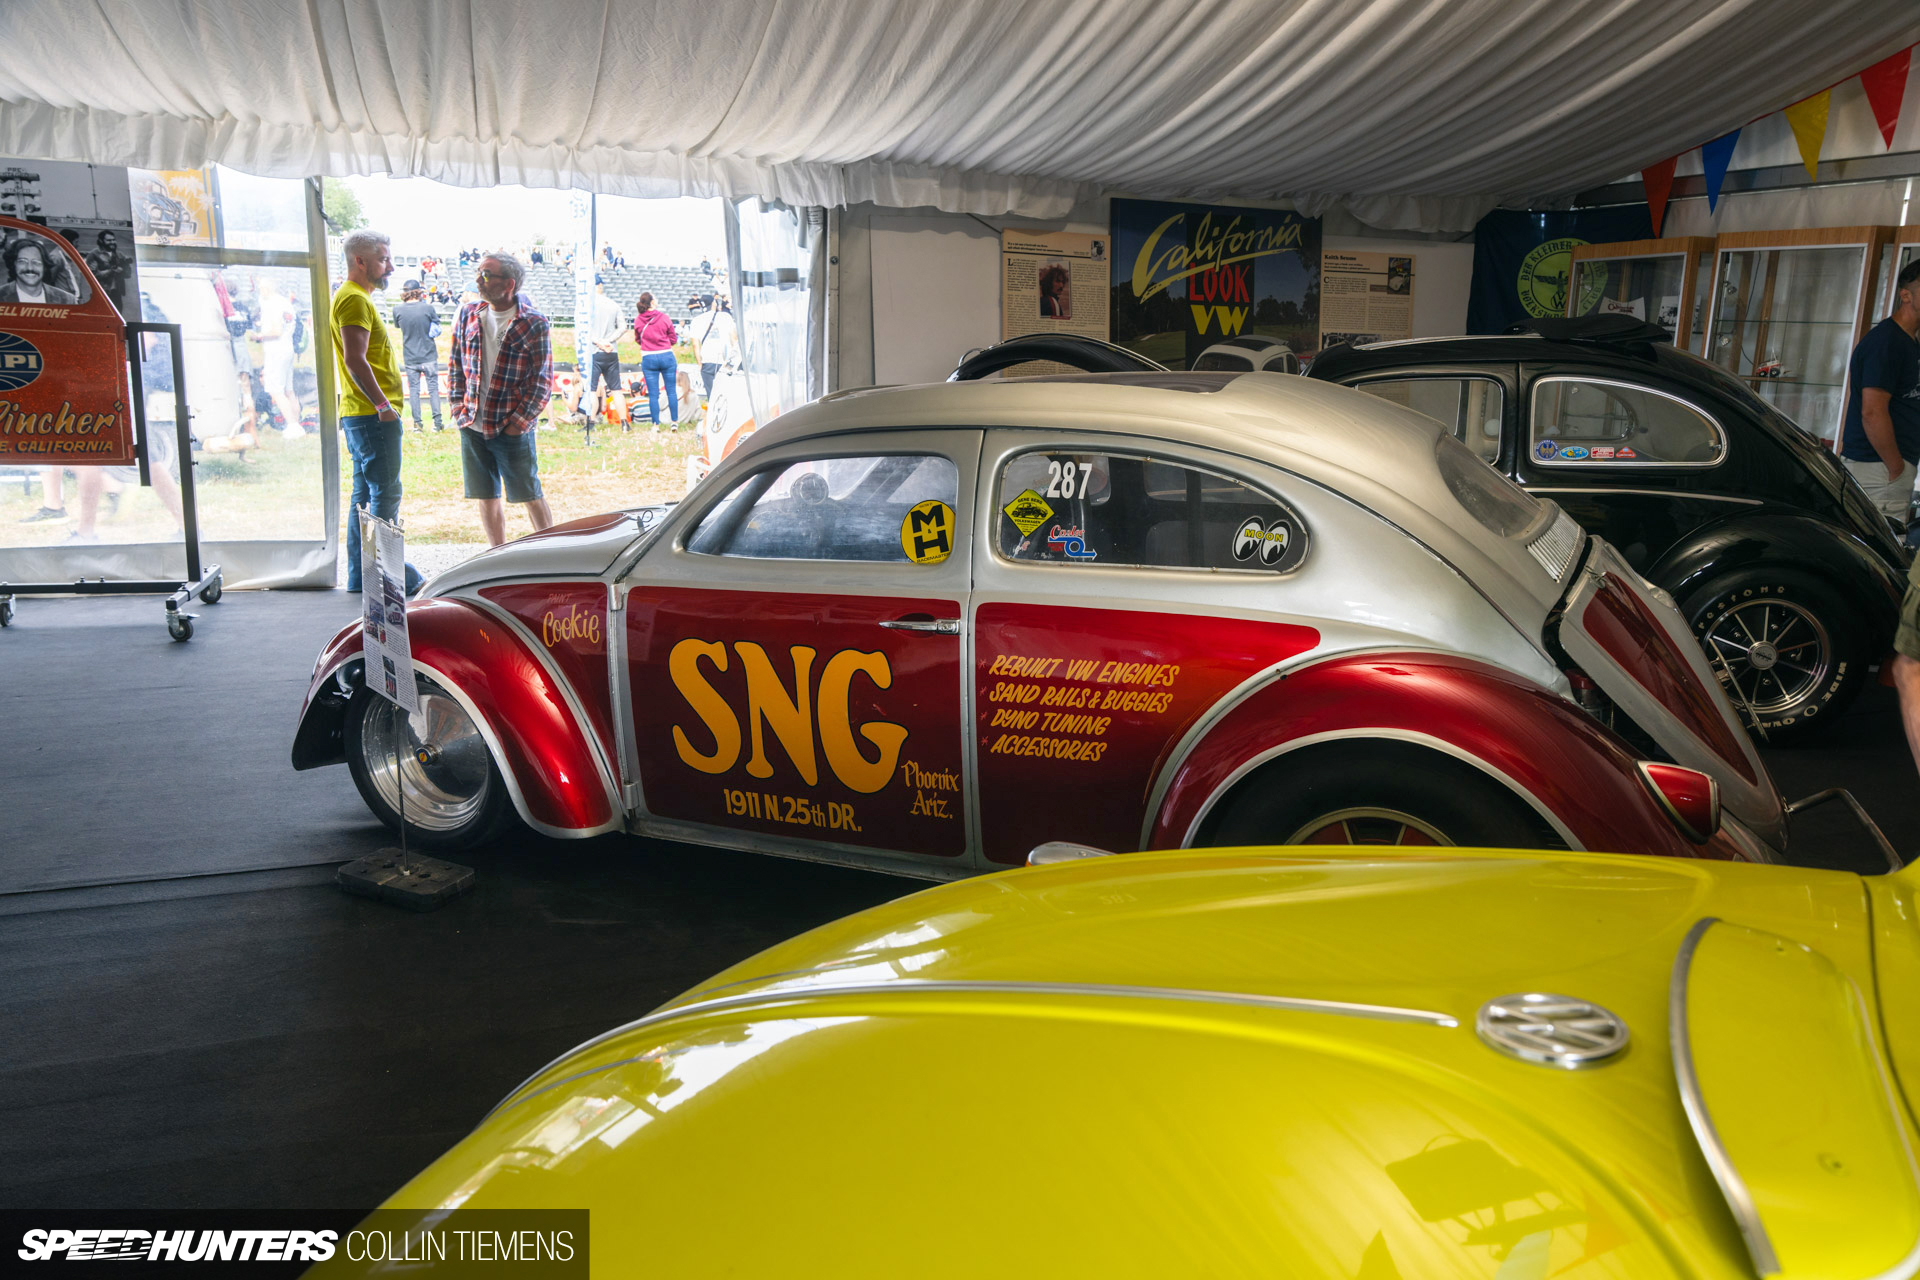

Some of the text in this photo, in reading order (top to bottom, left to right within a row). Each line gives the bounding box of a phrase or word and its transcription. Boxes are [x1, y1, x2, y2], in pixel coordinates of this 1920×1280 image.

[1132, 210, 1302, 298] California
[1520, 262, 1533, 281] DER
[1529, 240, 1572, 262] KLEINER
[1189, 262, 1250, 303] LOOK
[20, 307, 70, 319] VITTONE
[1190, 304, 1249, 336] VW
[0, 354, 38, 369] PI
[16, 440, 113, 454] CALIFORNIA
[1047, 461, 1092, 500] 287
[911, 504, 945, 533] M
[914, 529, 950, 559] H
[1244, 528, 1284, 542] MOON
[543, 603, 600, 648] Cookie
[989, 655, 1180, 687] REBUILT VW ENGINES
[989, 682, 1174, 714] SAND RAILS & BUGGIES
[668, 637, 909, 794] SNG
[990, 708, 1112, 736] DYNO TUNING
[990, 734, 1108, 762] ACCESSORIES
[901, 760, 960, 793] Phoenix
[724, 789, 761, 819] 1911
[828, 803, 863, 832] DR.
[909, 790, 953, 819] Ariz.
